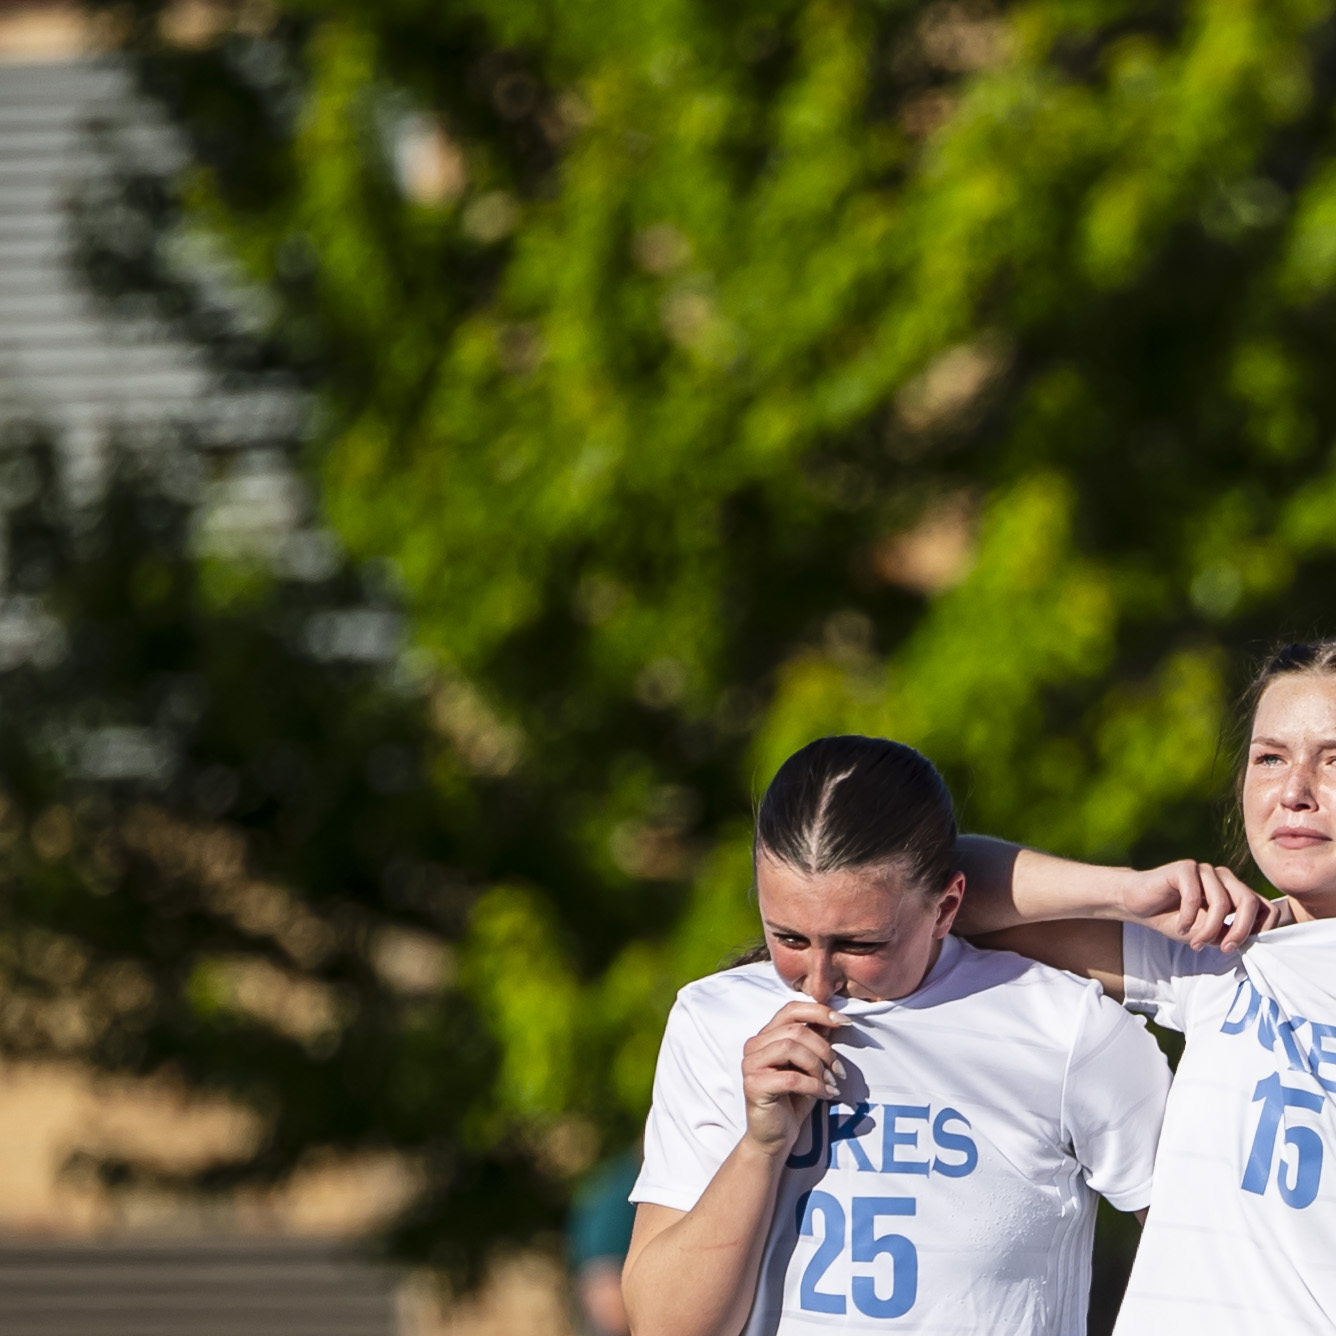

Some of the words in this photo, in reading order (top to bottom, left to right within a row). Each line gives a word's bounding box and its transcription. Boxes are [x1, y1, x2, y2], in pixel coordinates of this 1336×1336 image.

[785, 1101, 978, 1180] UKES
[1241, 1071, 1326, 1210] 15
[795, 1189, 918, 1320] 25
